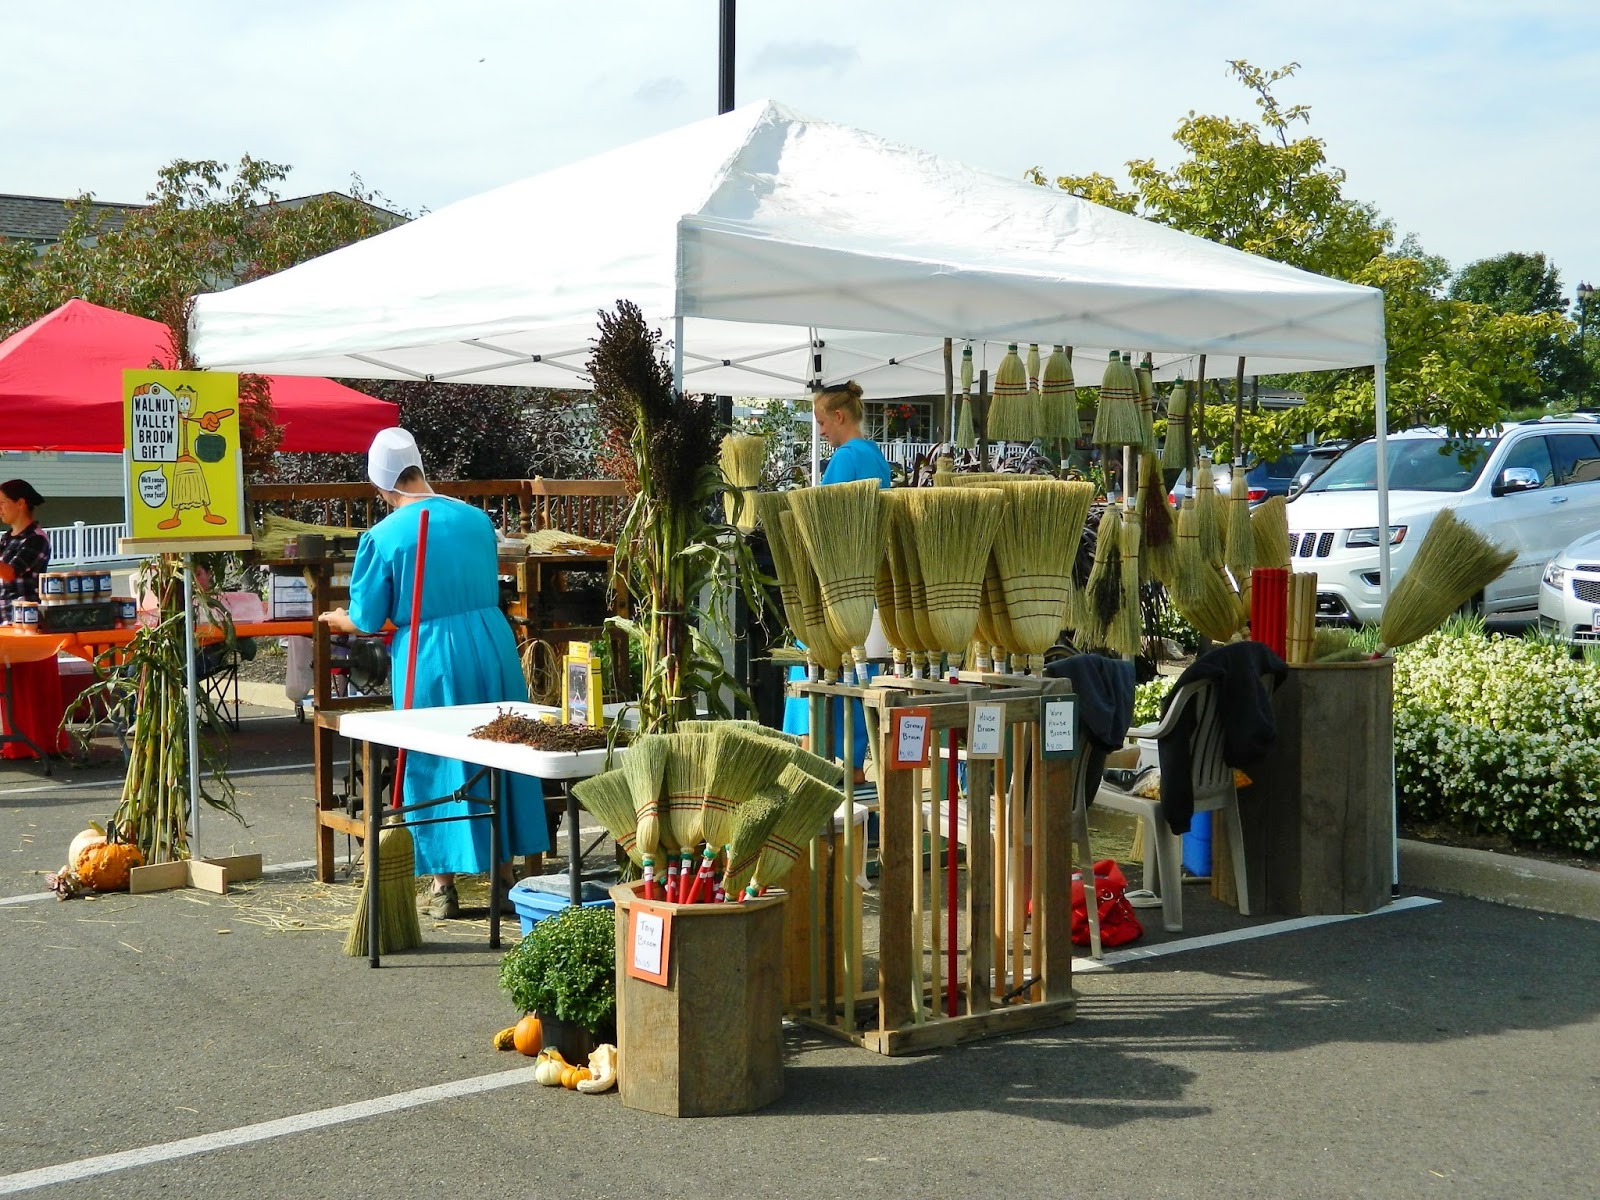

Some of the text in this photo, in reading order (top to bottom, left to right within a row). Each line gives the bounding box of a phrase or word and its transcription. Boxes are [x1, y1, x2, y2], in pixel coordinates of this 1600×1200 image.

[135, 398, 174, 412] WALNUT
[136, 415, 174, 428] VALLEY
[139, 430, 172, 444] BROOM
[142, 446, 164, 459] GIFT
[980, 712, 996, 721] House
[904, 720, 924, 731] Granny
[978, 724, 996, 732] Broom
[902, 732, 920, 740] Broom
[640, 920, 654, 936] Toy
[638, 934, 656, 947] Broom
